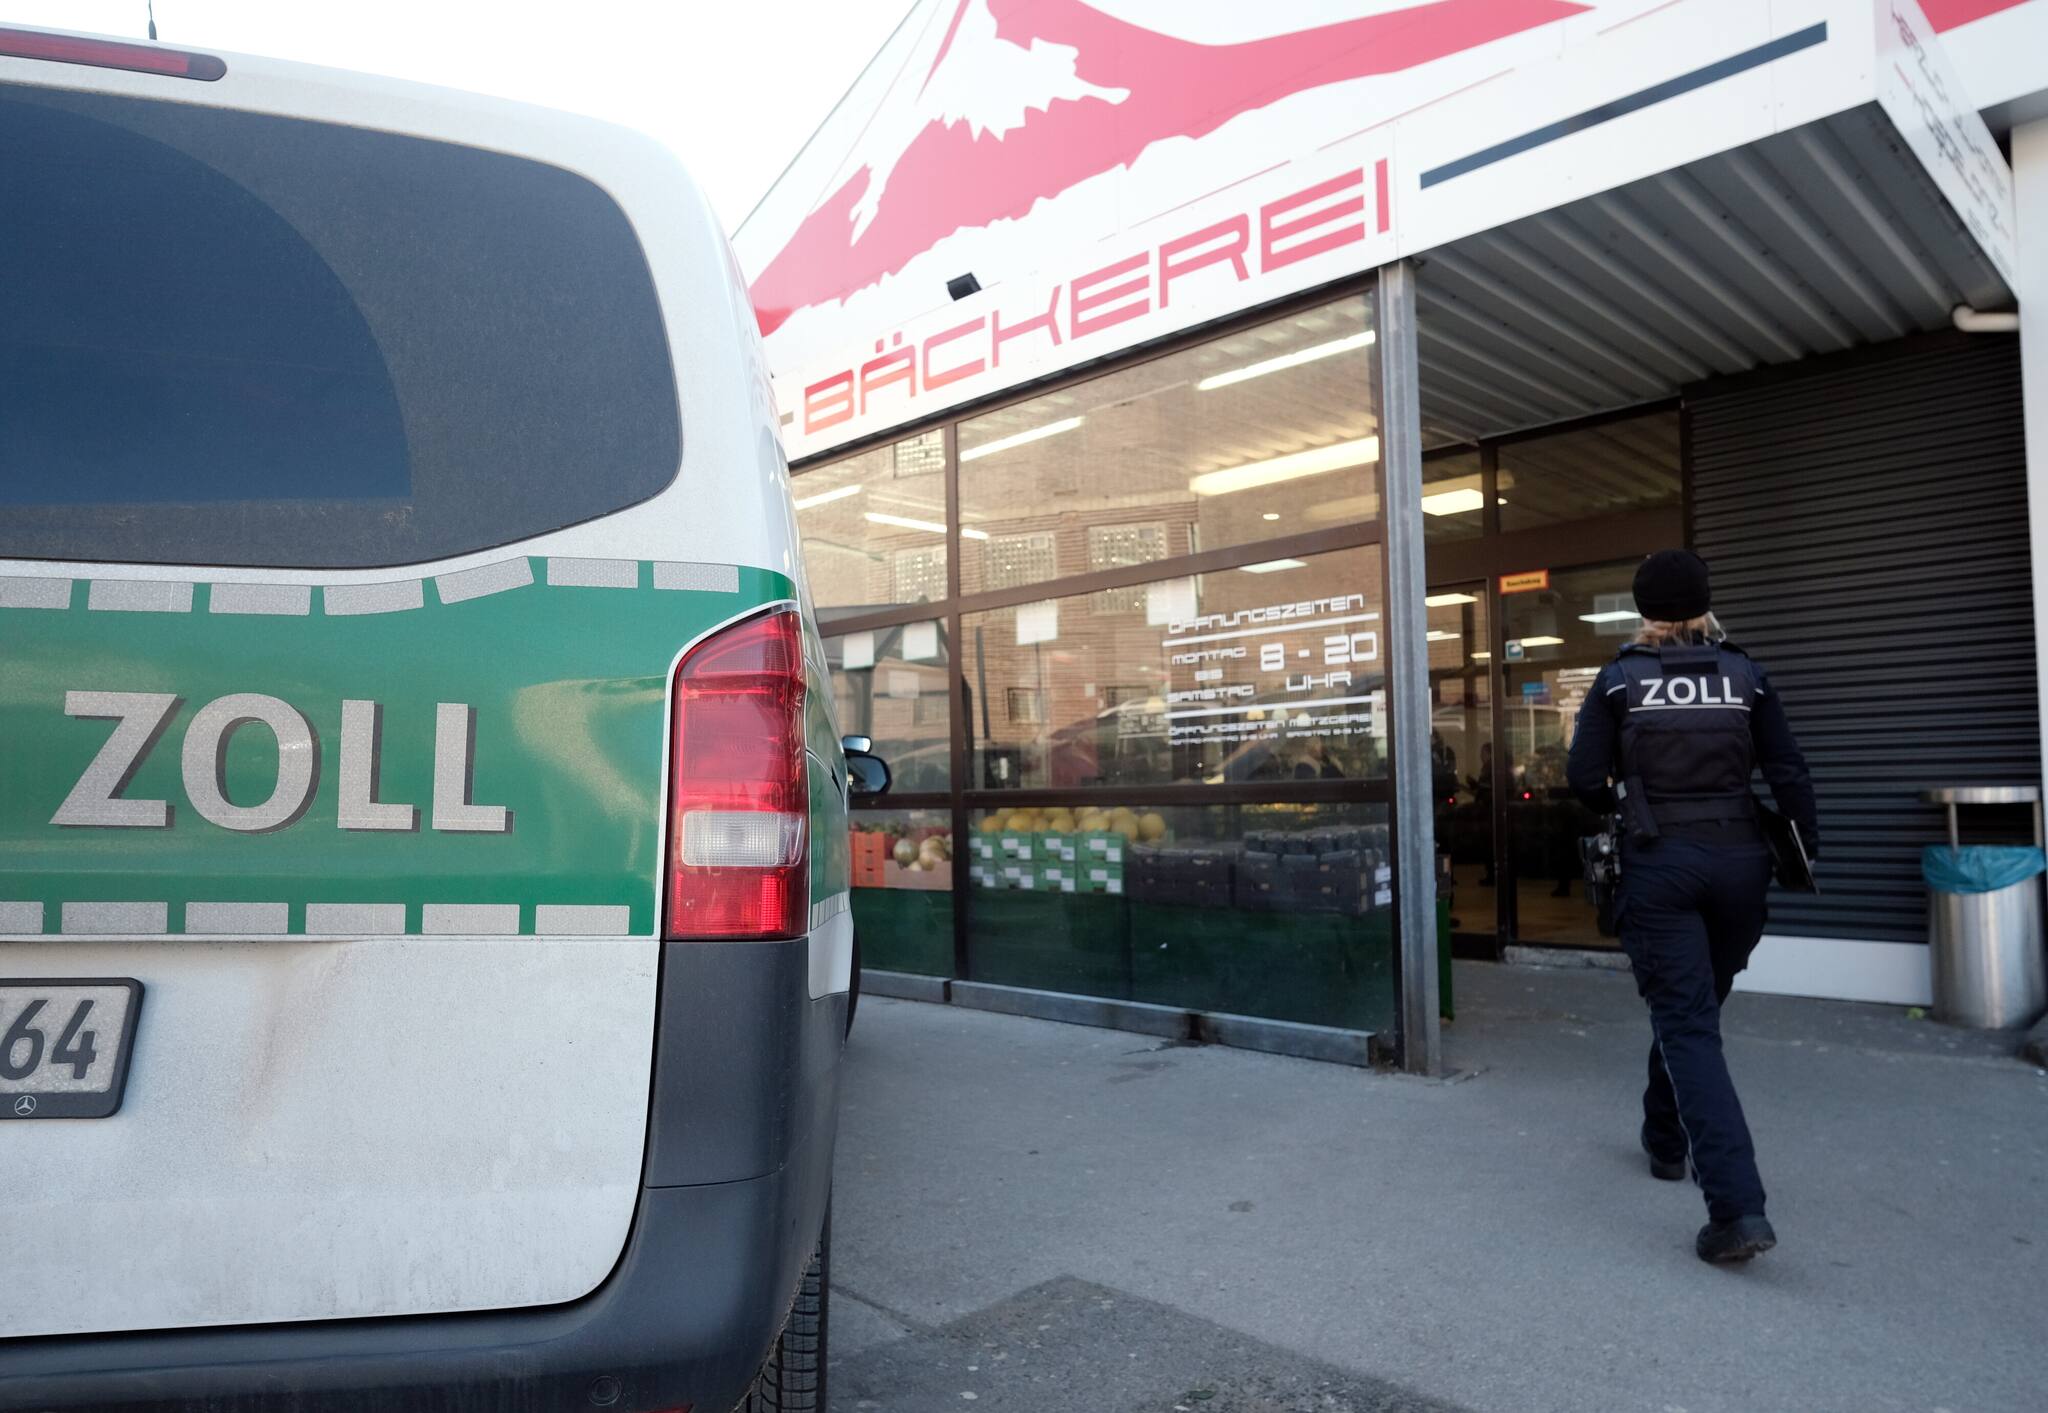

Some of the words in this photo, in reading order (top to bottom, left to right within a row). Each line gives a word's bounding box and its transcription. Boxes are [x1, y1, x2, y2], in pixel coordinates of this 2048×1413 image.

[804, 157, 1390, 436] BÄCKEREI
[1260, 642, 1284, 672] 8
[1324, 631, 1377, 665] 20
[1286, 671, 1351, 691] UHR
[1640, 676, 1743, 706] ZOLL
[50, 691, 512, 834] ZOLL
[0, 999, 97, 1080] 64
